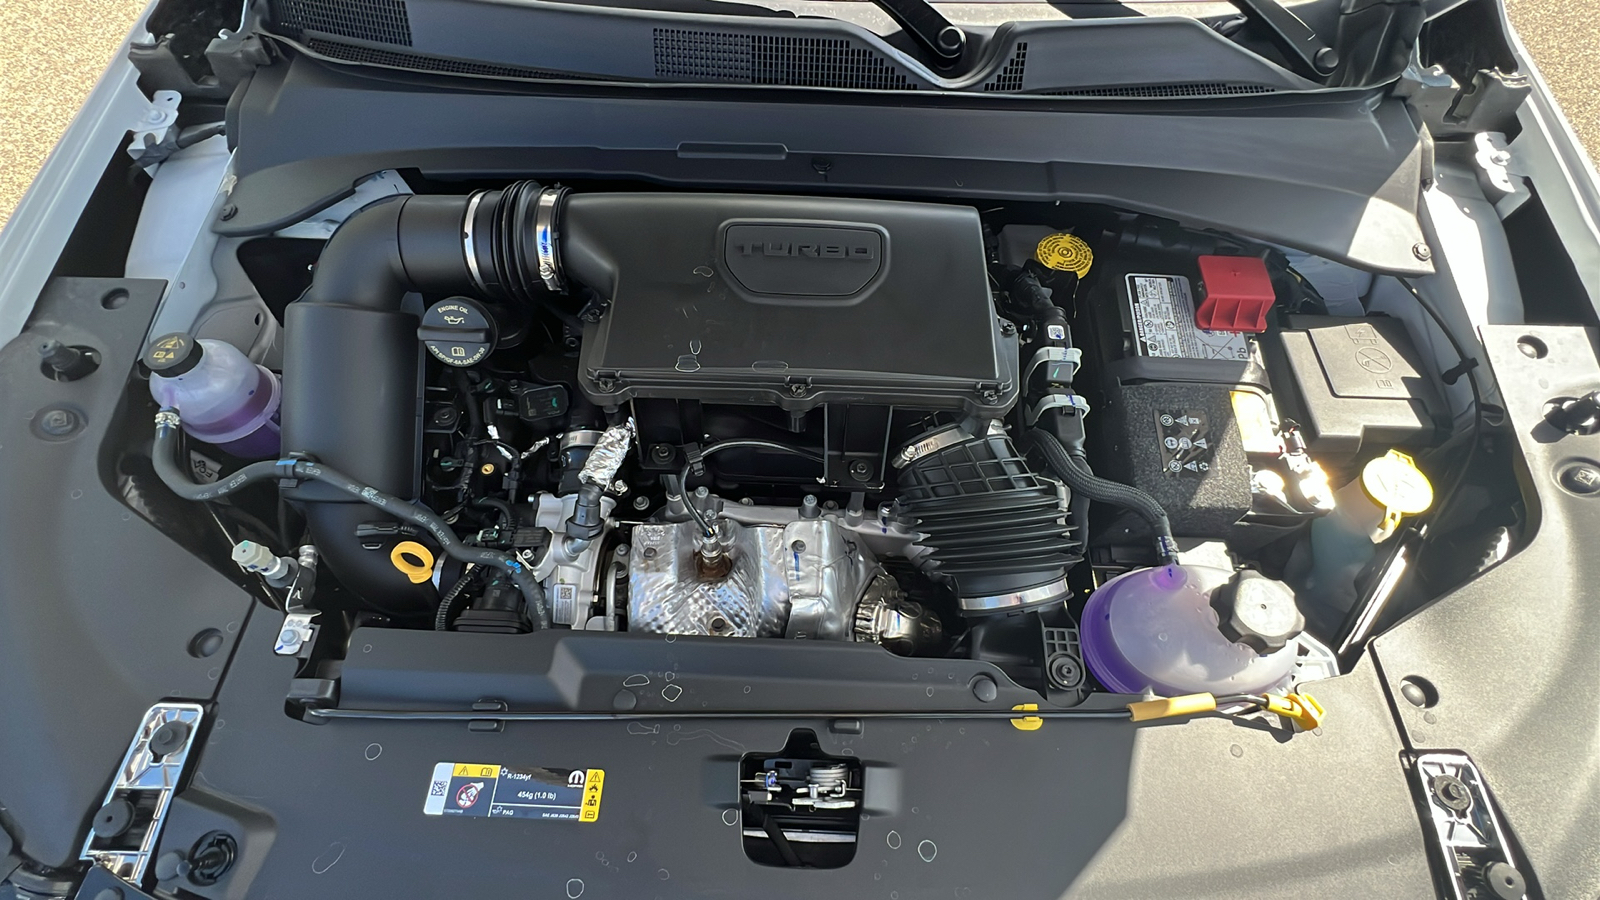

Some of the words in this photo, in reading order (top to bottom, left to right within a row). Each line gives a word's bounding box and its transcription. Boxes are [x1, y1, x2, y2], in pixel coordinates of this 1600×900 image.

[735, 241, 875, 260] TURBO
[437, 305, 459, 314] ENGINE
[459, 306, 469, 315] OIL
[507, 773, 533, 782] R-1234yf
[517, 790, 534, 800] 454g
[534, 791, 547, 800] (1.0
[547, 792, 557, 801] lb)
